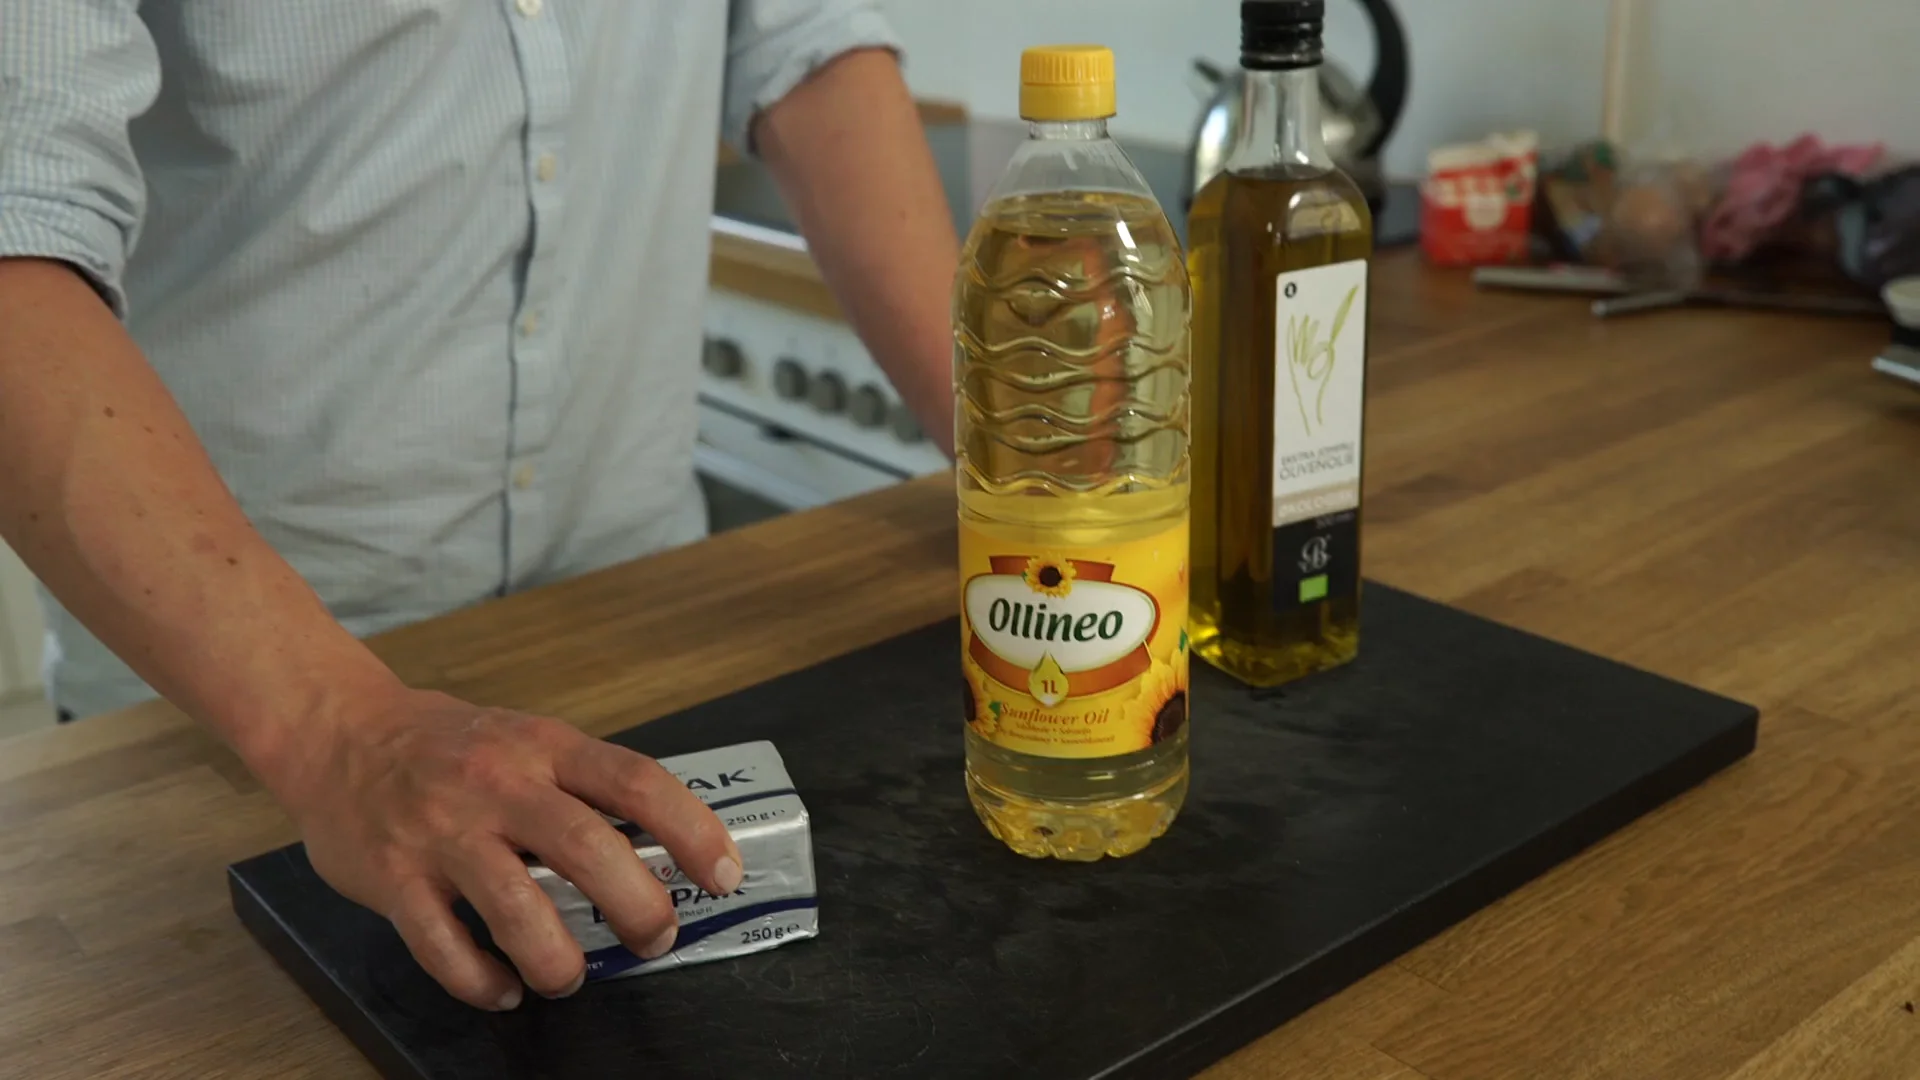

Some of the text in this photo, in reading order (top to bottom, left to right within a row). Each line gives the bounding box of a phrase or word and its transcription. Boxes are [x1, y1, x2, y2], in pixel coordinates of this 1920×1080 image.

[989, 597, 1124, 642] Ollineo
[1041, 680, 1058, 694] 1L
[1001, 703, 1110, 725] Sunflower Oil
[685, 769, 755, 790] AK
[741, 927, 771, 944] 250
